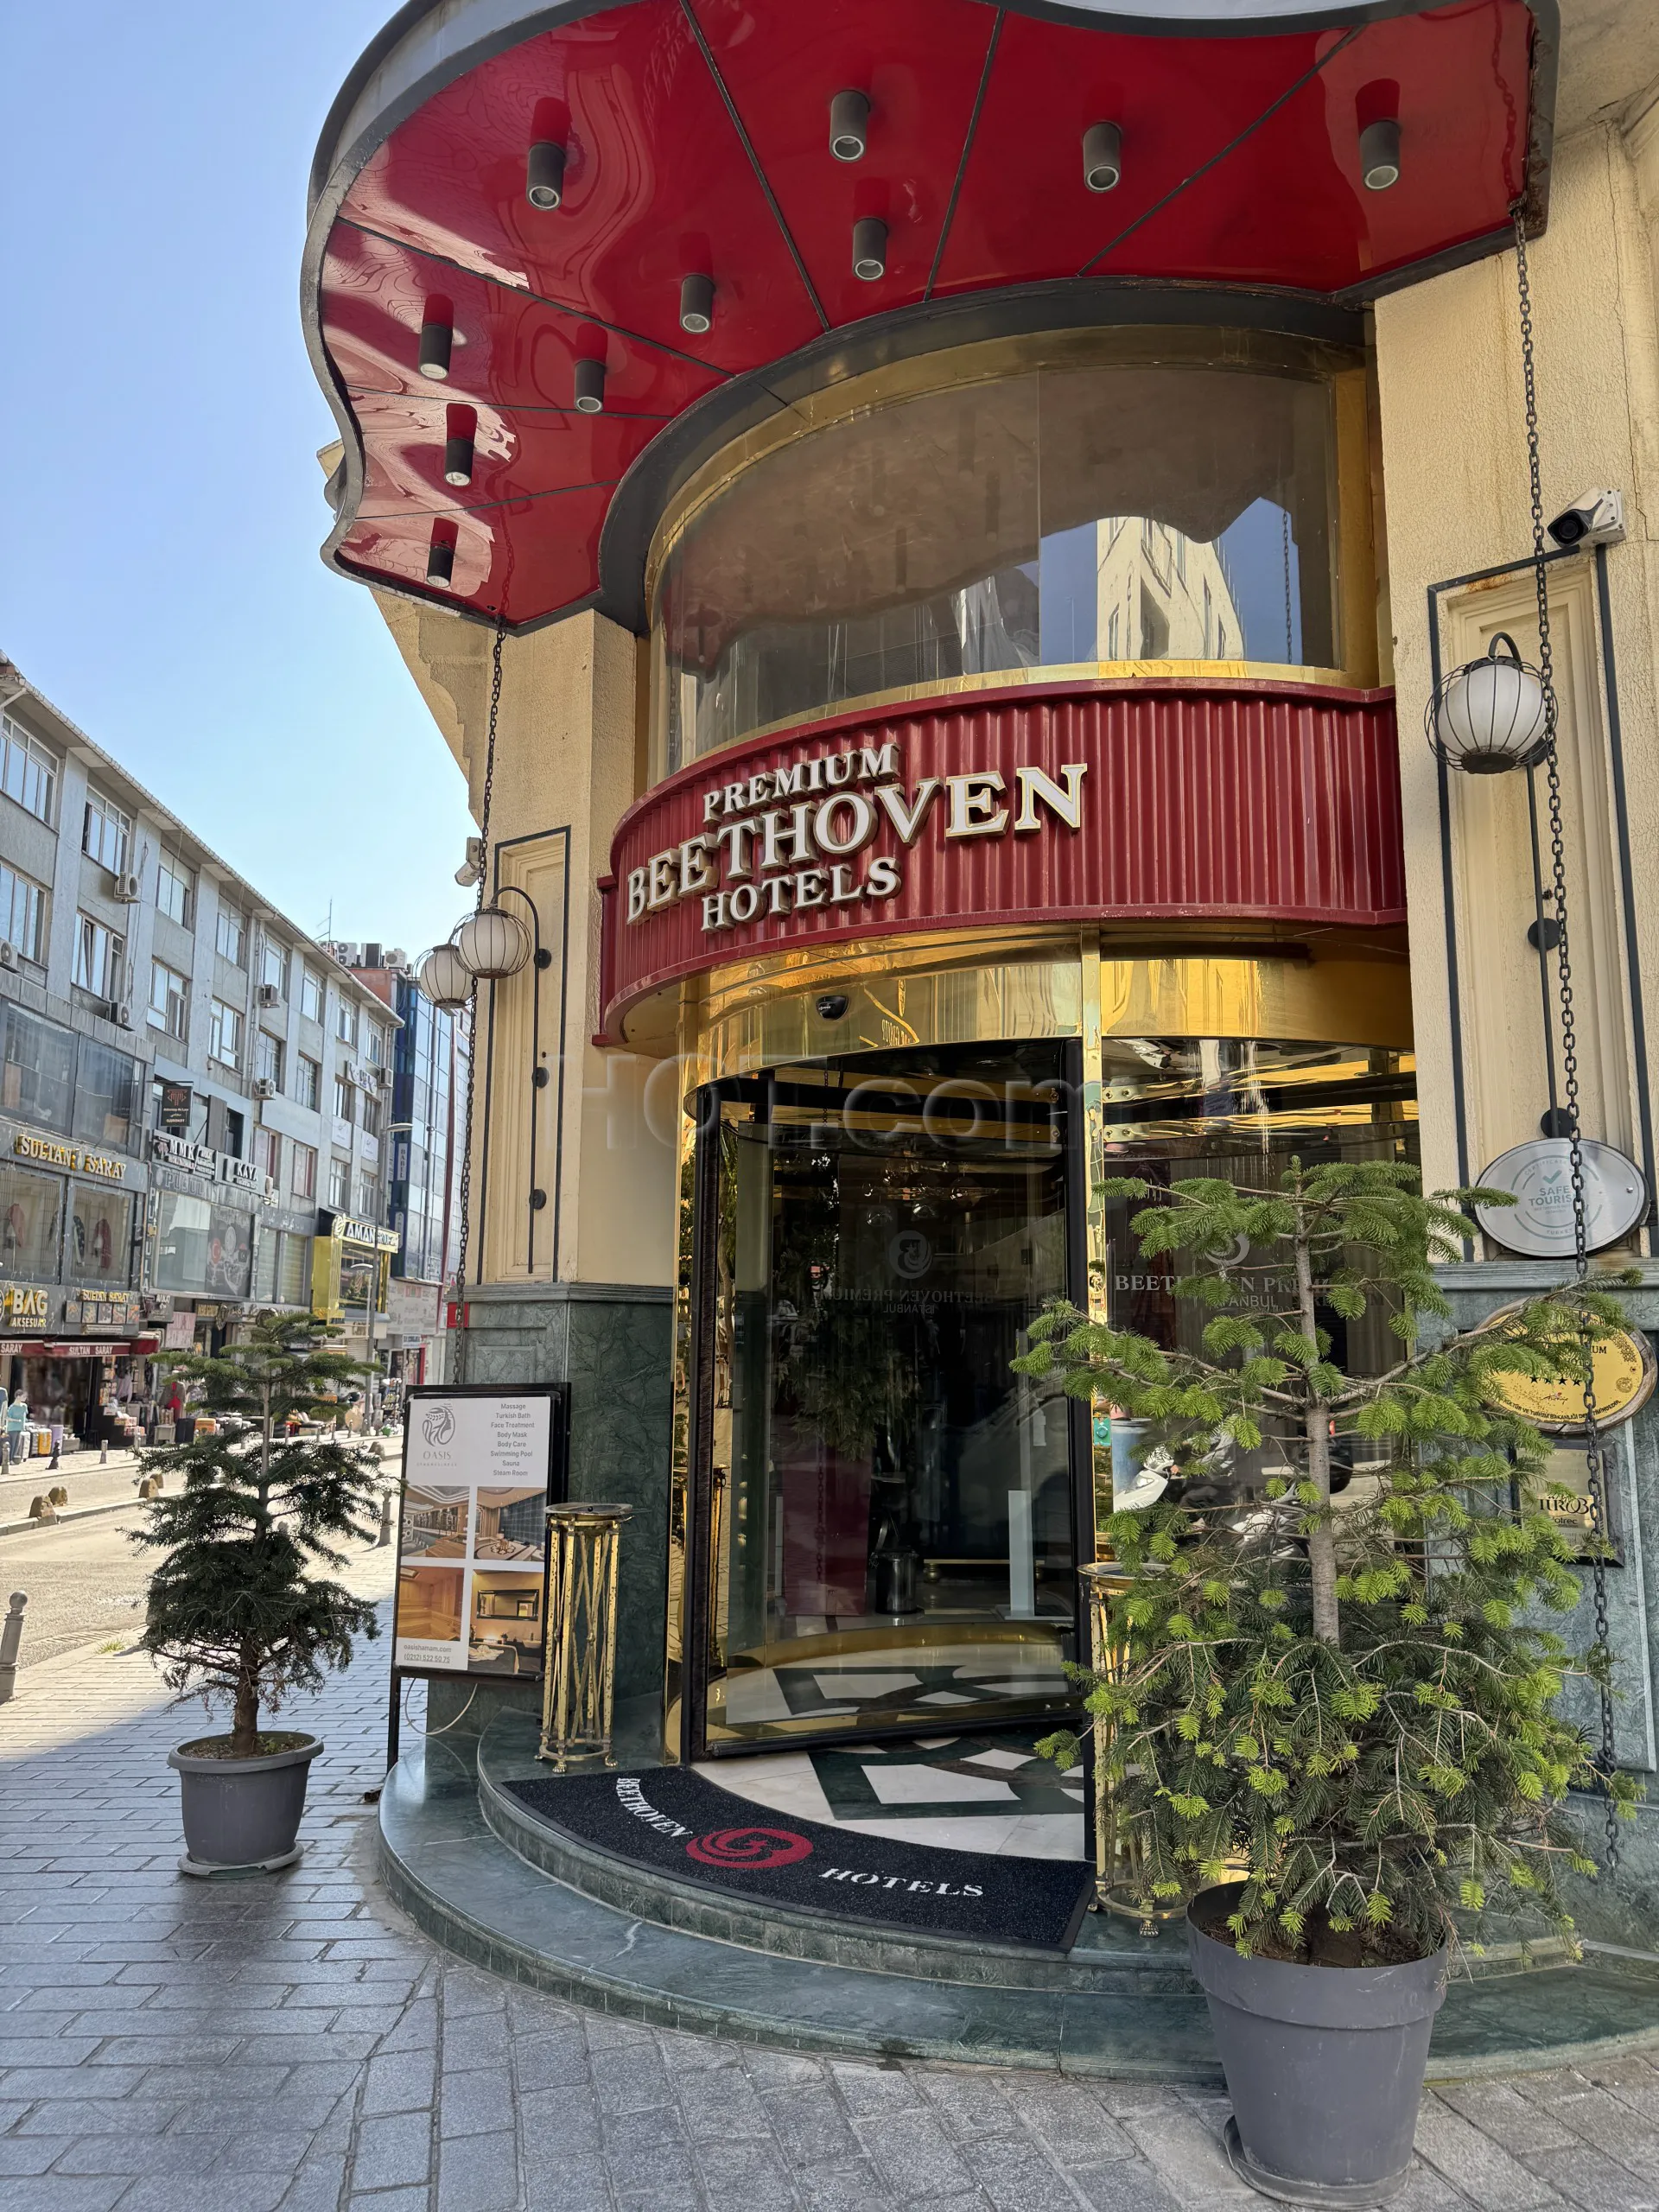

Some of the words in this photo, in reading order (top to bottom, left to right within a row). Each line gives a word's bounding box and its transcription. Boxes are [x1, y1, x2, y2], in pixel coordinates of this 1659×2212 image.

[703, 741, 901, 824] PREMIUM
[626, 763, 1088, 926] BEETHOVEN
[701, 856, 901, 934] HOTELS
[170, 1139, 195, 1160] MMK
[18, 1134, 72, 1167] SULTAN
[86, 1154, 127, 1180] SARAY
[238, 1161, 258, 1180] KAYA
[1539, 1185, 1571, 1197] SAFE
[1528, 1194, 1576, 1207] TOURIS
[143, 1187, 156, 1294] PUULA
[13, 1288, 48, 1316] BAG
[12, 1317, 47, 1328] AKSESUAR
[0, 1344, 22, 1354] SARAY
[69, 1346, 91, 1355] SULTAN
[95, 1346, 113, 1355] SARAY
[500, 1402, 526, 1411] Massage
[497, 1431, 512, 1440] Body
[423, 1451, 451, 1460] OASIS
[490, 1450, 519, 1459] Swimming
[1552, 1516, 1579, 1525] otrec
[404, 1643, 452, 1652] oasishamam.com
[616, 1777, 694, 1837] BEETHOVEN
[818, 1867, 985, 1898] HOTELS
